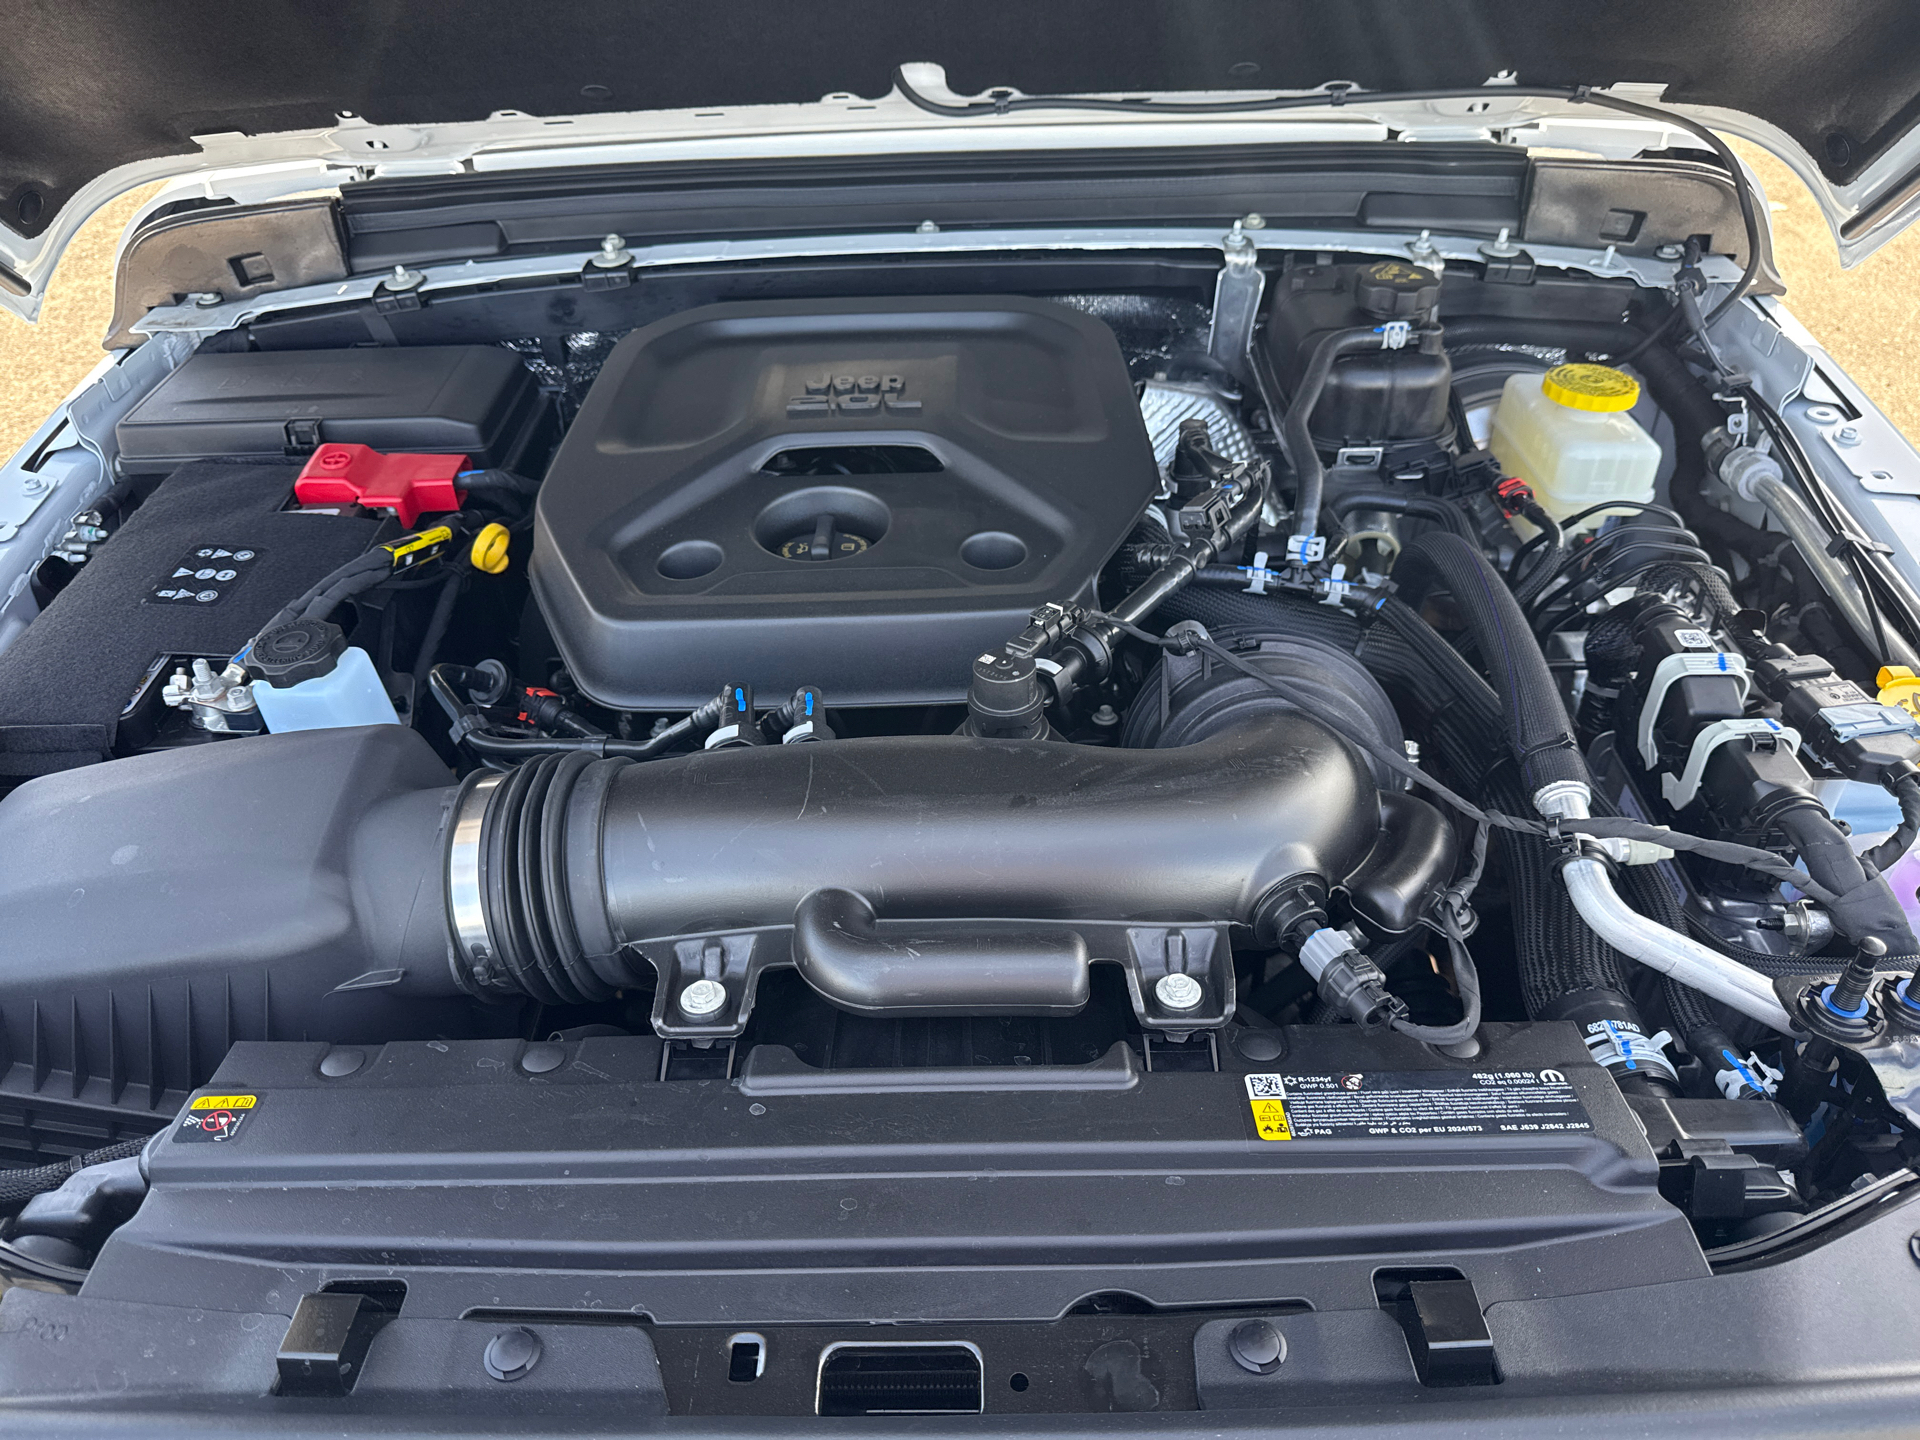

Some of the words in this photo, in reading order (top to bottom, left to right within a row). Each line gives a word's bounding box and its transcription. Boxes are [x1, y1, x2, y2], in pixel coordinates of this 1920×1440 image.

[805, 372, 906, 394] Jeep
[786, 393, 922, 414] 2.0L
[1587, 1020, 1641, 1034] 682781AD
